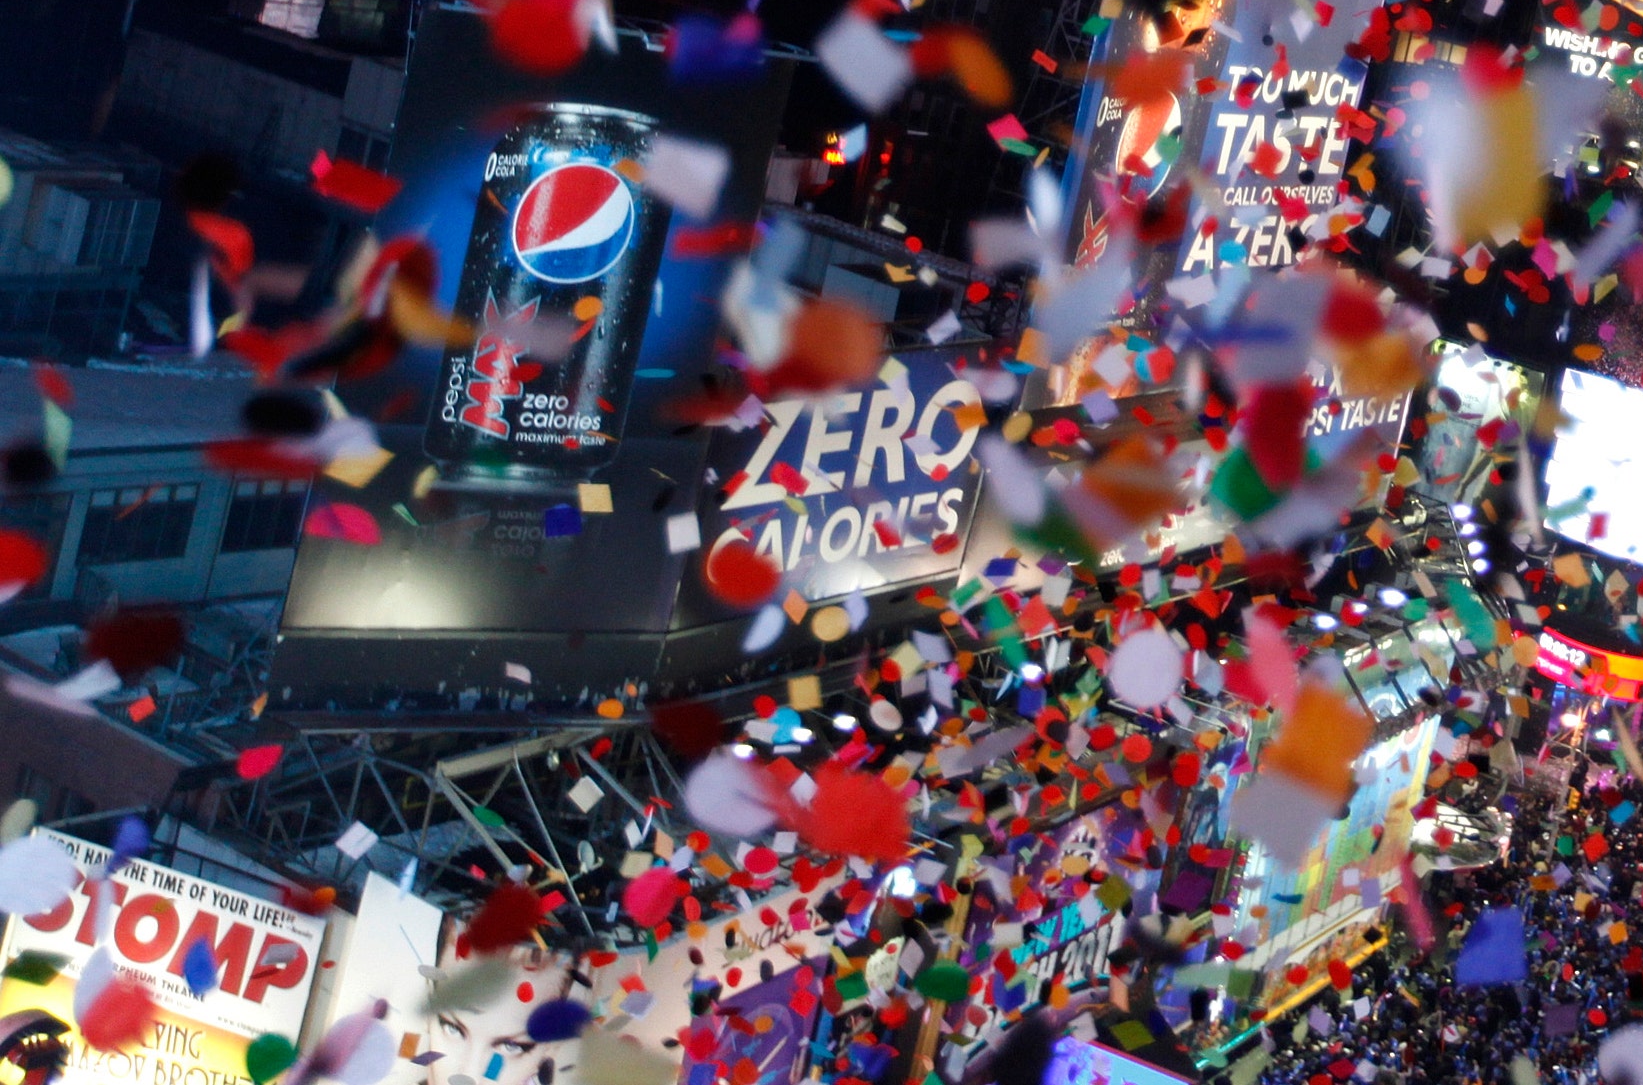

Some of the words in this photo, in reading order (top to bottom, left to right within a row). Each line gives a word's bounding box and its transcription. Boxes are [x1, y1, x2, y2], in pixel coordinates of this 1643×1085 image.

[1545, 27, 1632, 61] WISHNG
[1570, 54, 1597, 77] TO
[1288, 70, 1361, 108] MUCH
[1217, 114, 1346, 175] TASTE
[495, 165, 516, 177] COLA
[1223, 186, 1259, 206] CALL
[442, 356, 466, 423] pepsi
[522, 393, 569, 411] zero
[519, 410, 602, 431] calories
[1341, 394, 1403, 431] TASTE
[720, 379, 984, 511] ZERO
[153, 869, 185, 896] TIME
[189, 882, 209, 903] OF
[212, 891, 250, 917] YOUR
[112, 962, 157, 986] RPHEUM
[153, 1056, 250, 1085] BROTH
